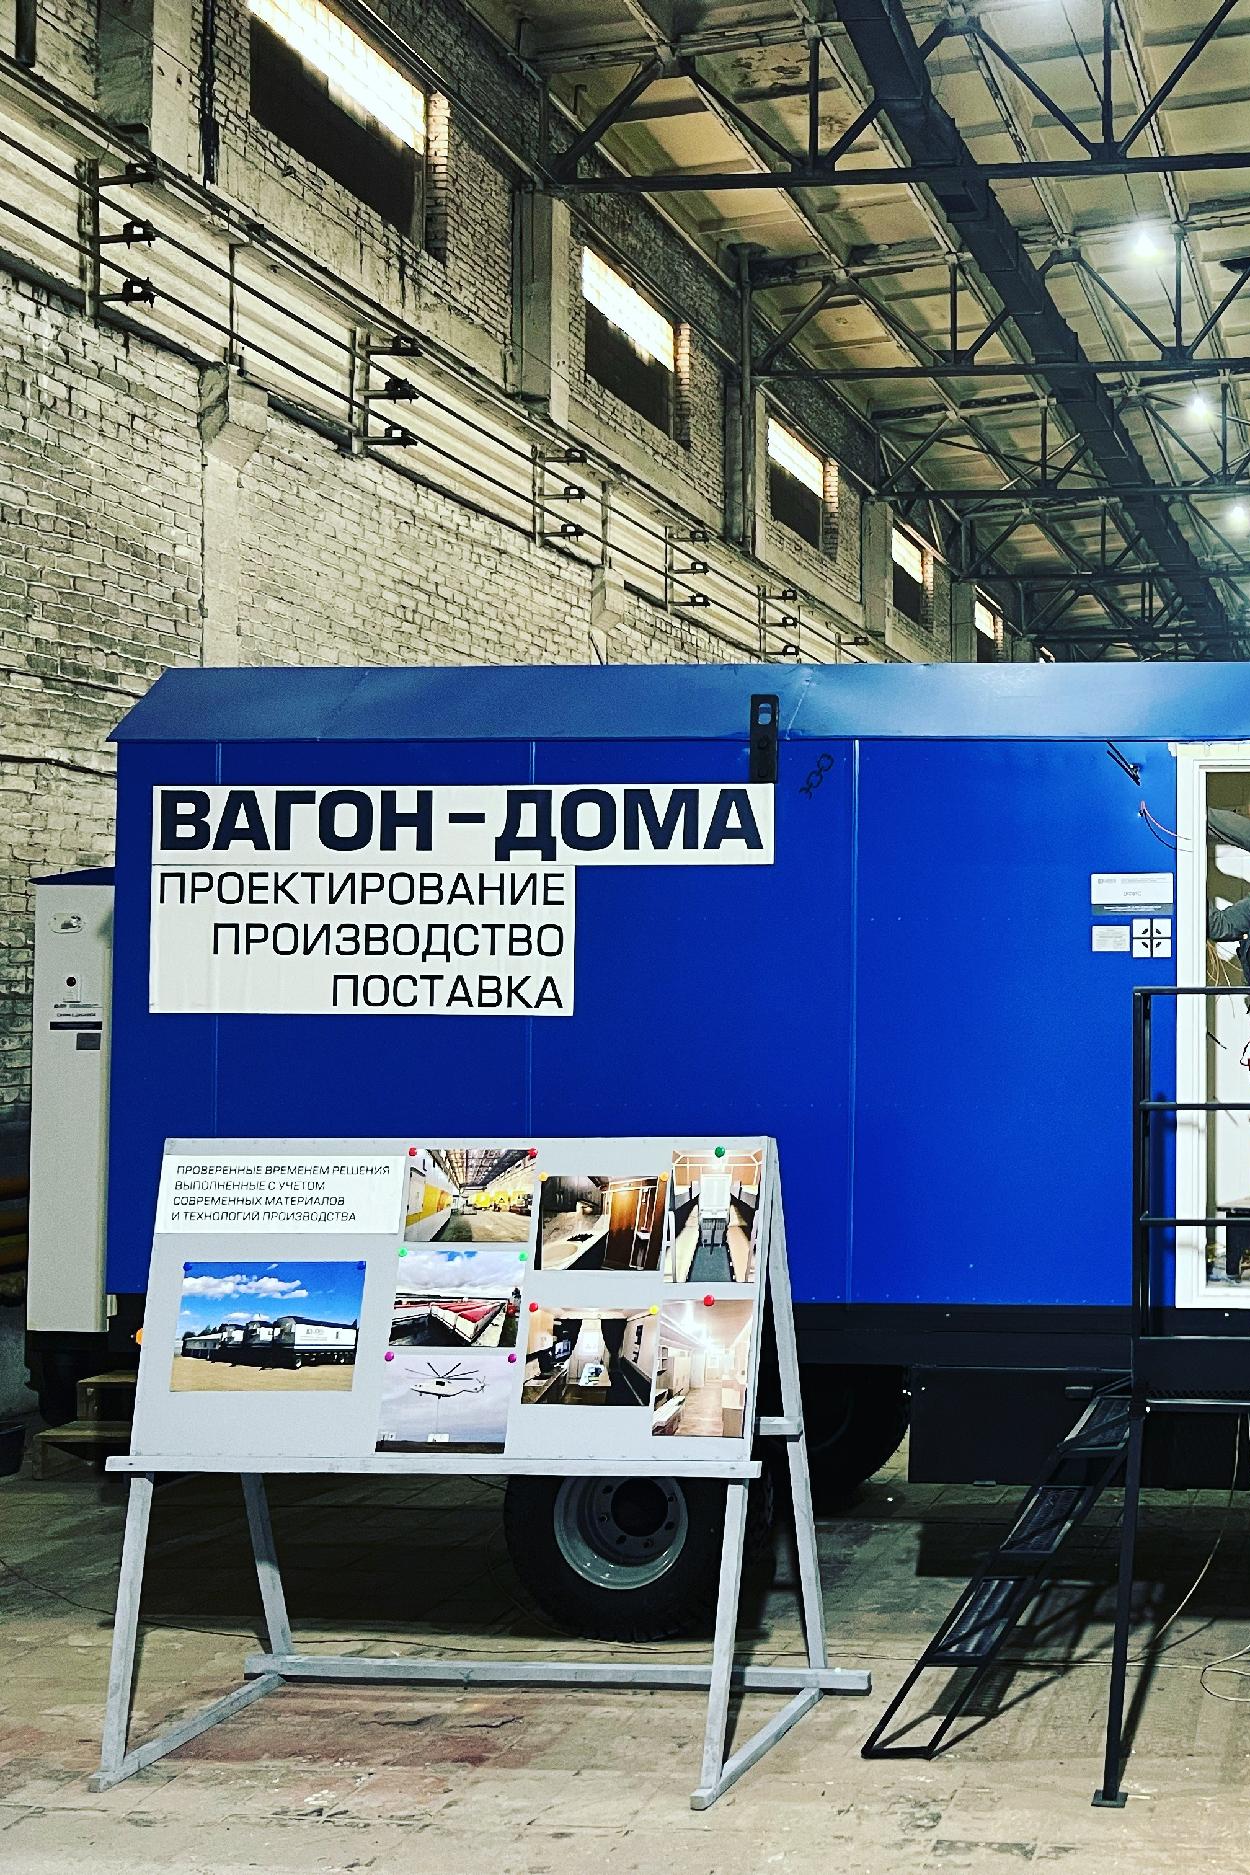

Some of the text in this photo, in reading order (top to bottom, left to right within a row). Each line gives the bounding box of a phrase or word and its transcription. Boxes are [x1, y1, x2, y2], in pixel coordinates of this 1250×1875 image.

[160, 788, 764, 862] ВАГОН-ДОМА
[159, 871, 565, 906] ПРОЕКТИРОВАНИЕ
[212, 922, 564, 963] ПРОИЗВОДСТВО
[332, 974, 564, 1009] ПОСТАВКА
[176, 1165, 390, 1176] ПРОВЕРЕННЫЕ ВРЕМЕНЕМ РЕШЕНИЯ
[174, 1180, 326, 1191] ВЫПОЛНЕННЫЕ С УЧЕТОМ
[173, 1196, 345, 1206] СОВРЕМЕННЫХ МАТЕРИАЛОВ
[171, 1210, 356, 1222] И ТЕХНОЛОГИЙ ПРОИЗВОДСТВА
